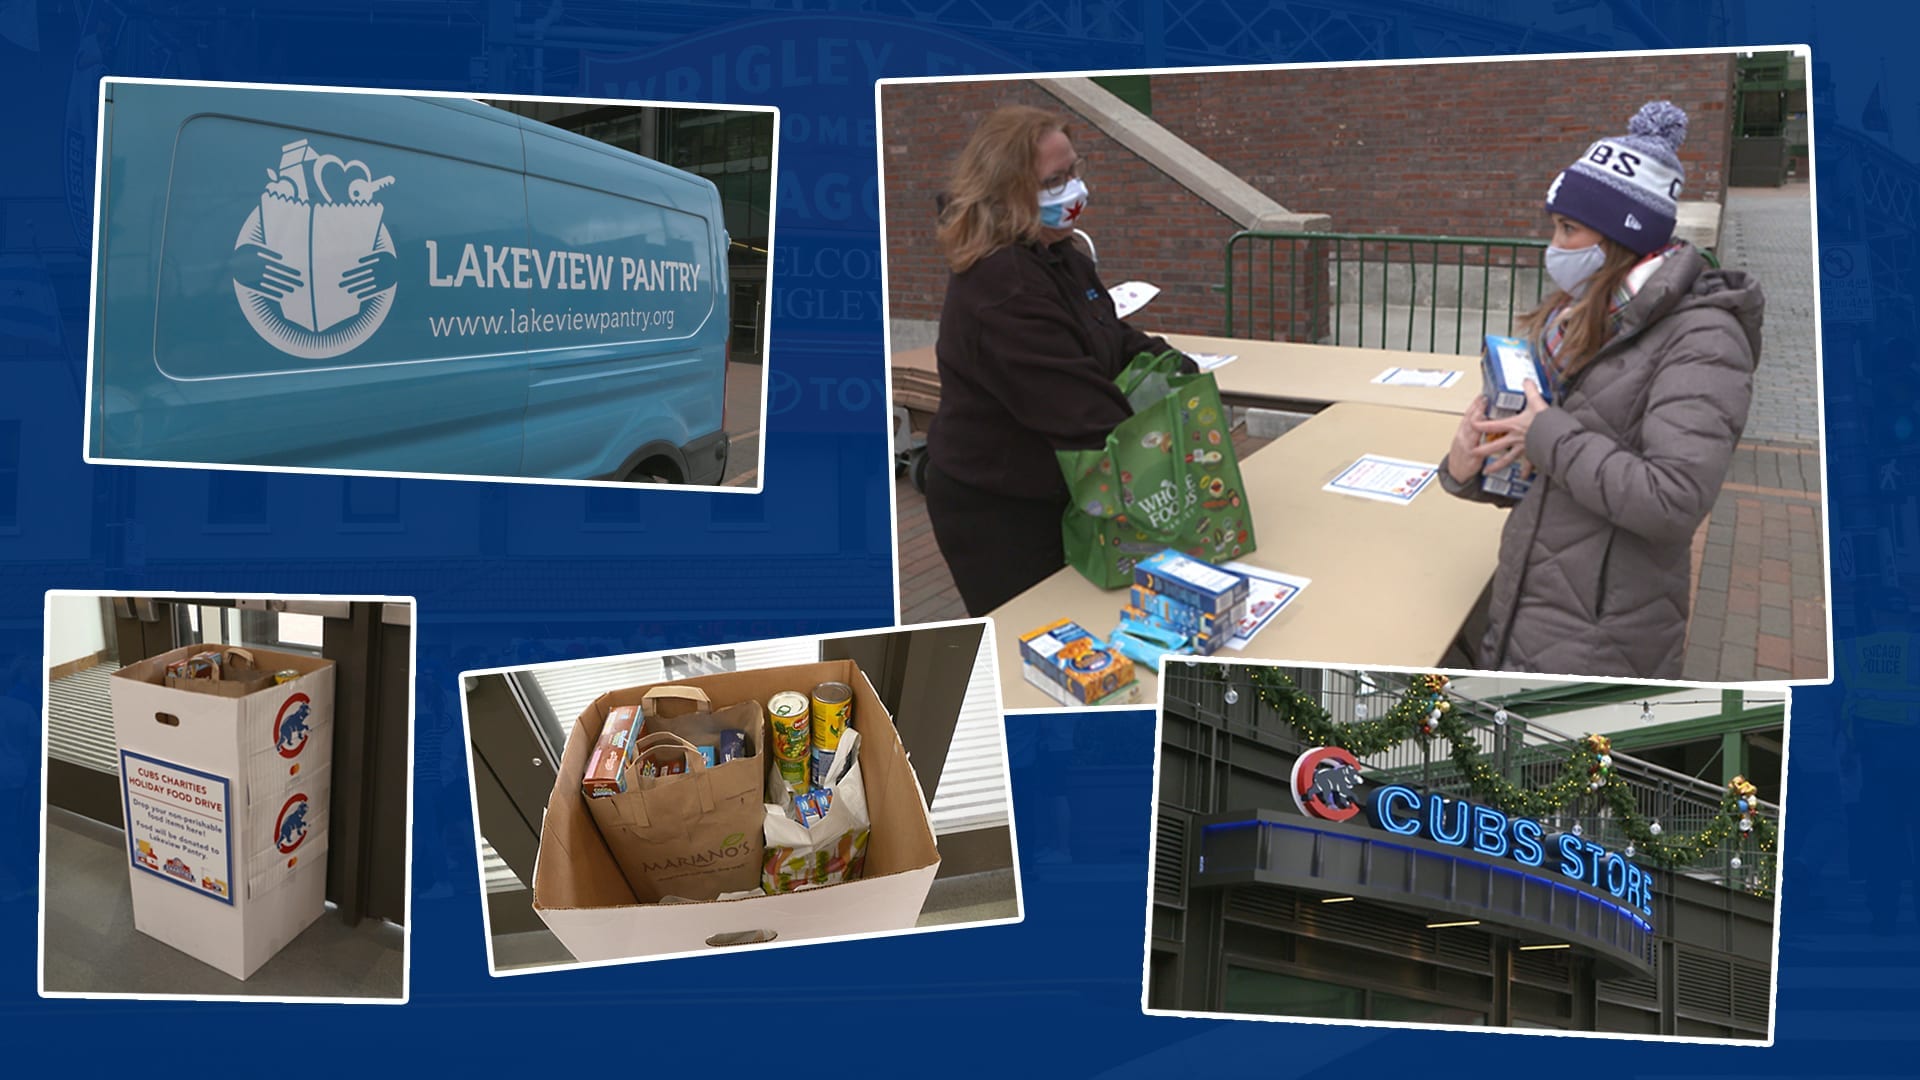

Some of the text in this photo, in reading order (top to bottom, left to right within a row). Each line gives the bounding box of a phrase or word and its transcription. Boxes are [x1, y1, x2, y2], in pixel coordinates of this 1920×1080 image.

[1589, 144, 1641, 178] BS
[425, 239, 701, 293] LAKEVIEW PANTRY
[429, 306, 675, 338] www.lakeviewpantry.org
[130, 777, 222, 811] HOLIDAY FOOD DRIVE
[138, 767, 207, 795] CUBS CHARITIES
[134, 799, 222, 832] Drop your non-perishable
[148, 812, 164, 823] food
[166, 817, 185, 829] items
[137, 821, 220, 855] Food will be donated to
[150, 834, 181, 849] Lakeview
[1375, 783, 1654, 917] CUBS STORE
[641, 840, 751, 874] MARIANO'S
